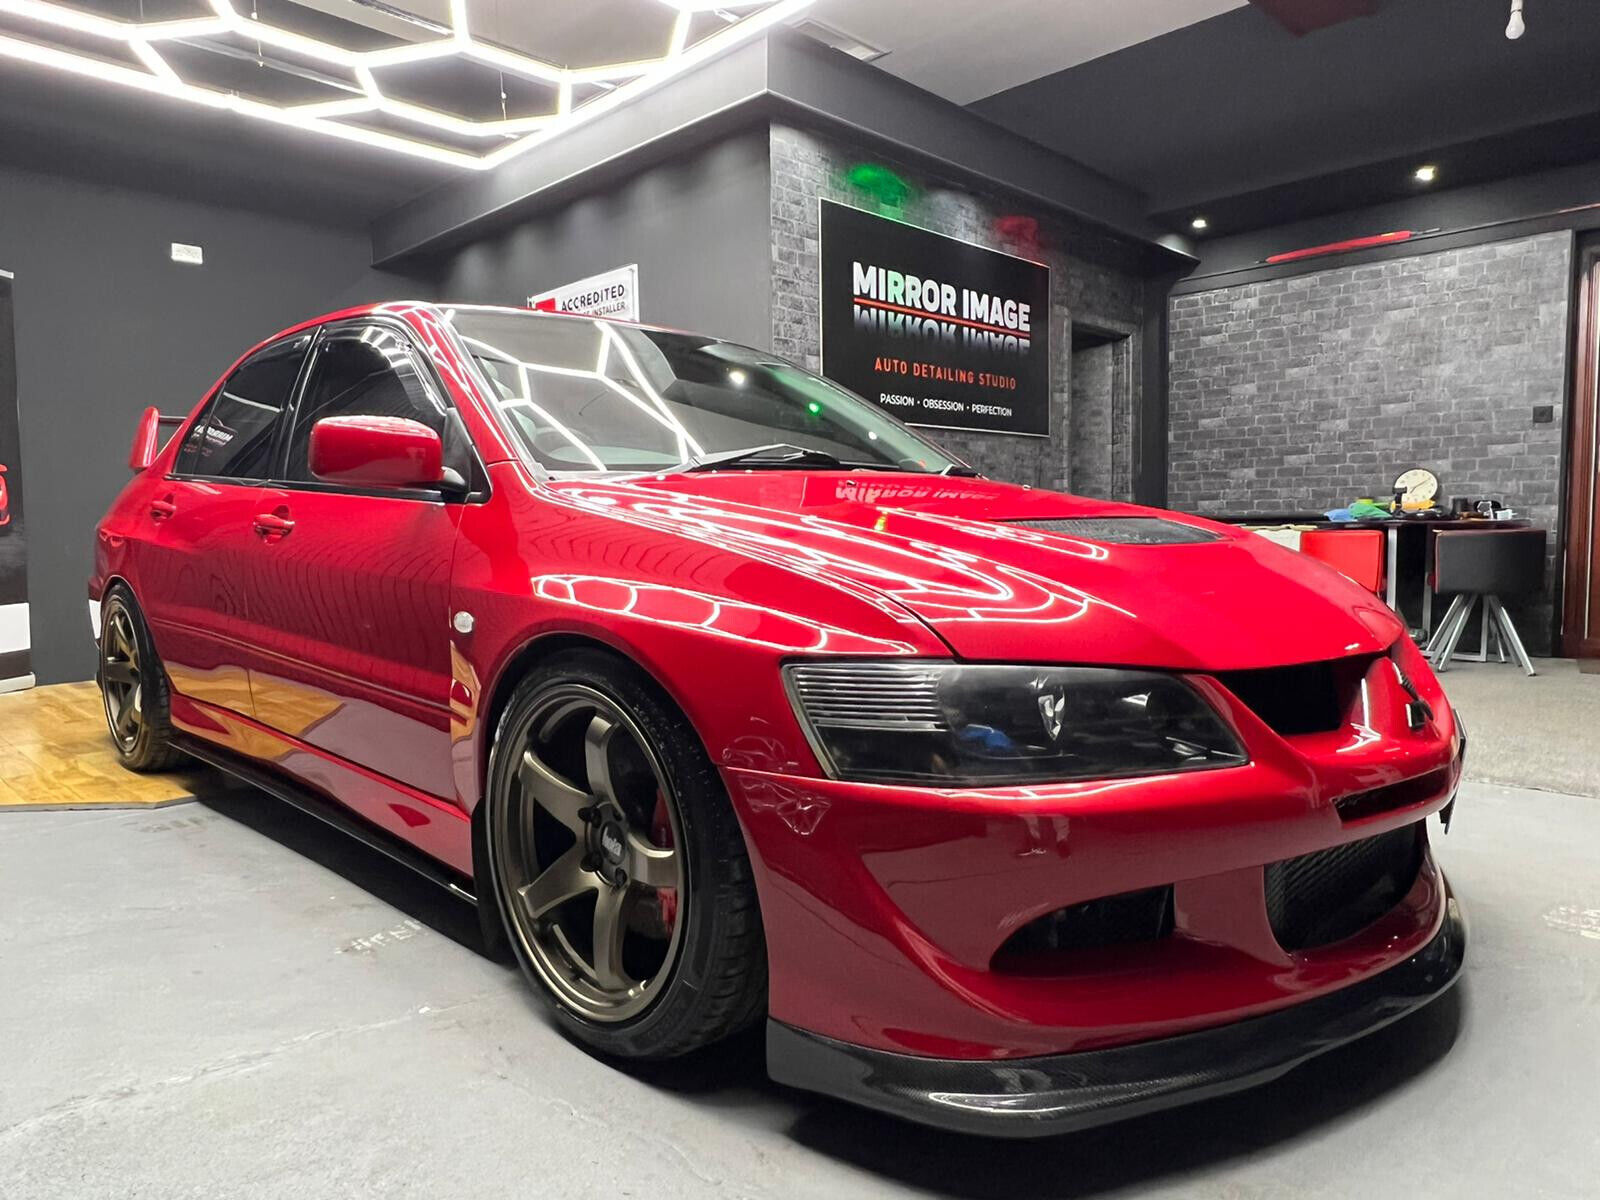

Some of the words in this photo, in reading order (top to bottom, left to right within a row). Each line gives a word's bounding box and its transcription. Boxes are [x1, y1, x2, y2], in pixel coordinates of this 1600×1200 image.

[561, 284, 625, 312] ACCREDITED
[853, 262, 957, 316] MIRROR
[962, 289, 1031, 331] IMAGE
[874, 357, 907, 375] AUTO
[912, 362, 975, 384] DETAILING
[978, 373, 1017, 390] STUDIO
[879, 393, 915, 407] PASSION
[922, 398, 965, 412] OBSESSION
[971, 404, 1013, 417] PERFECTION
